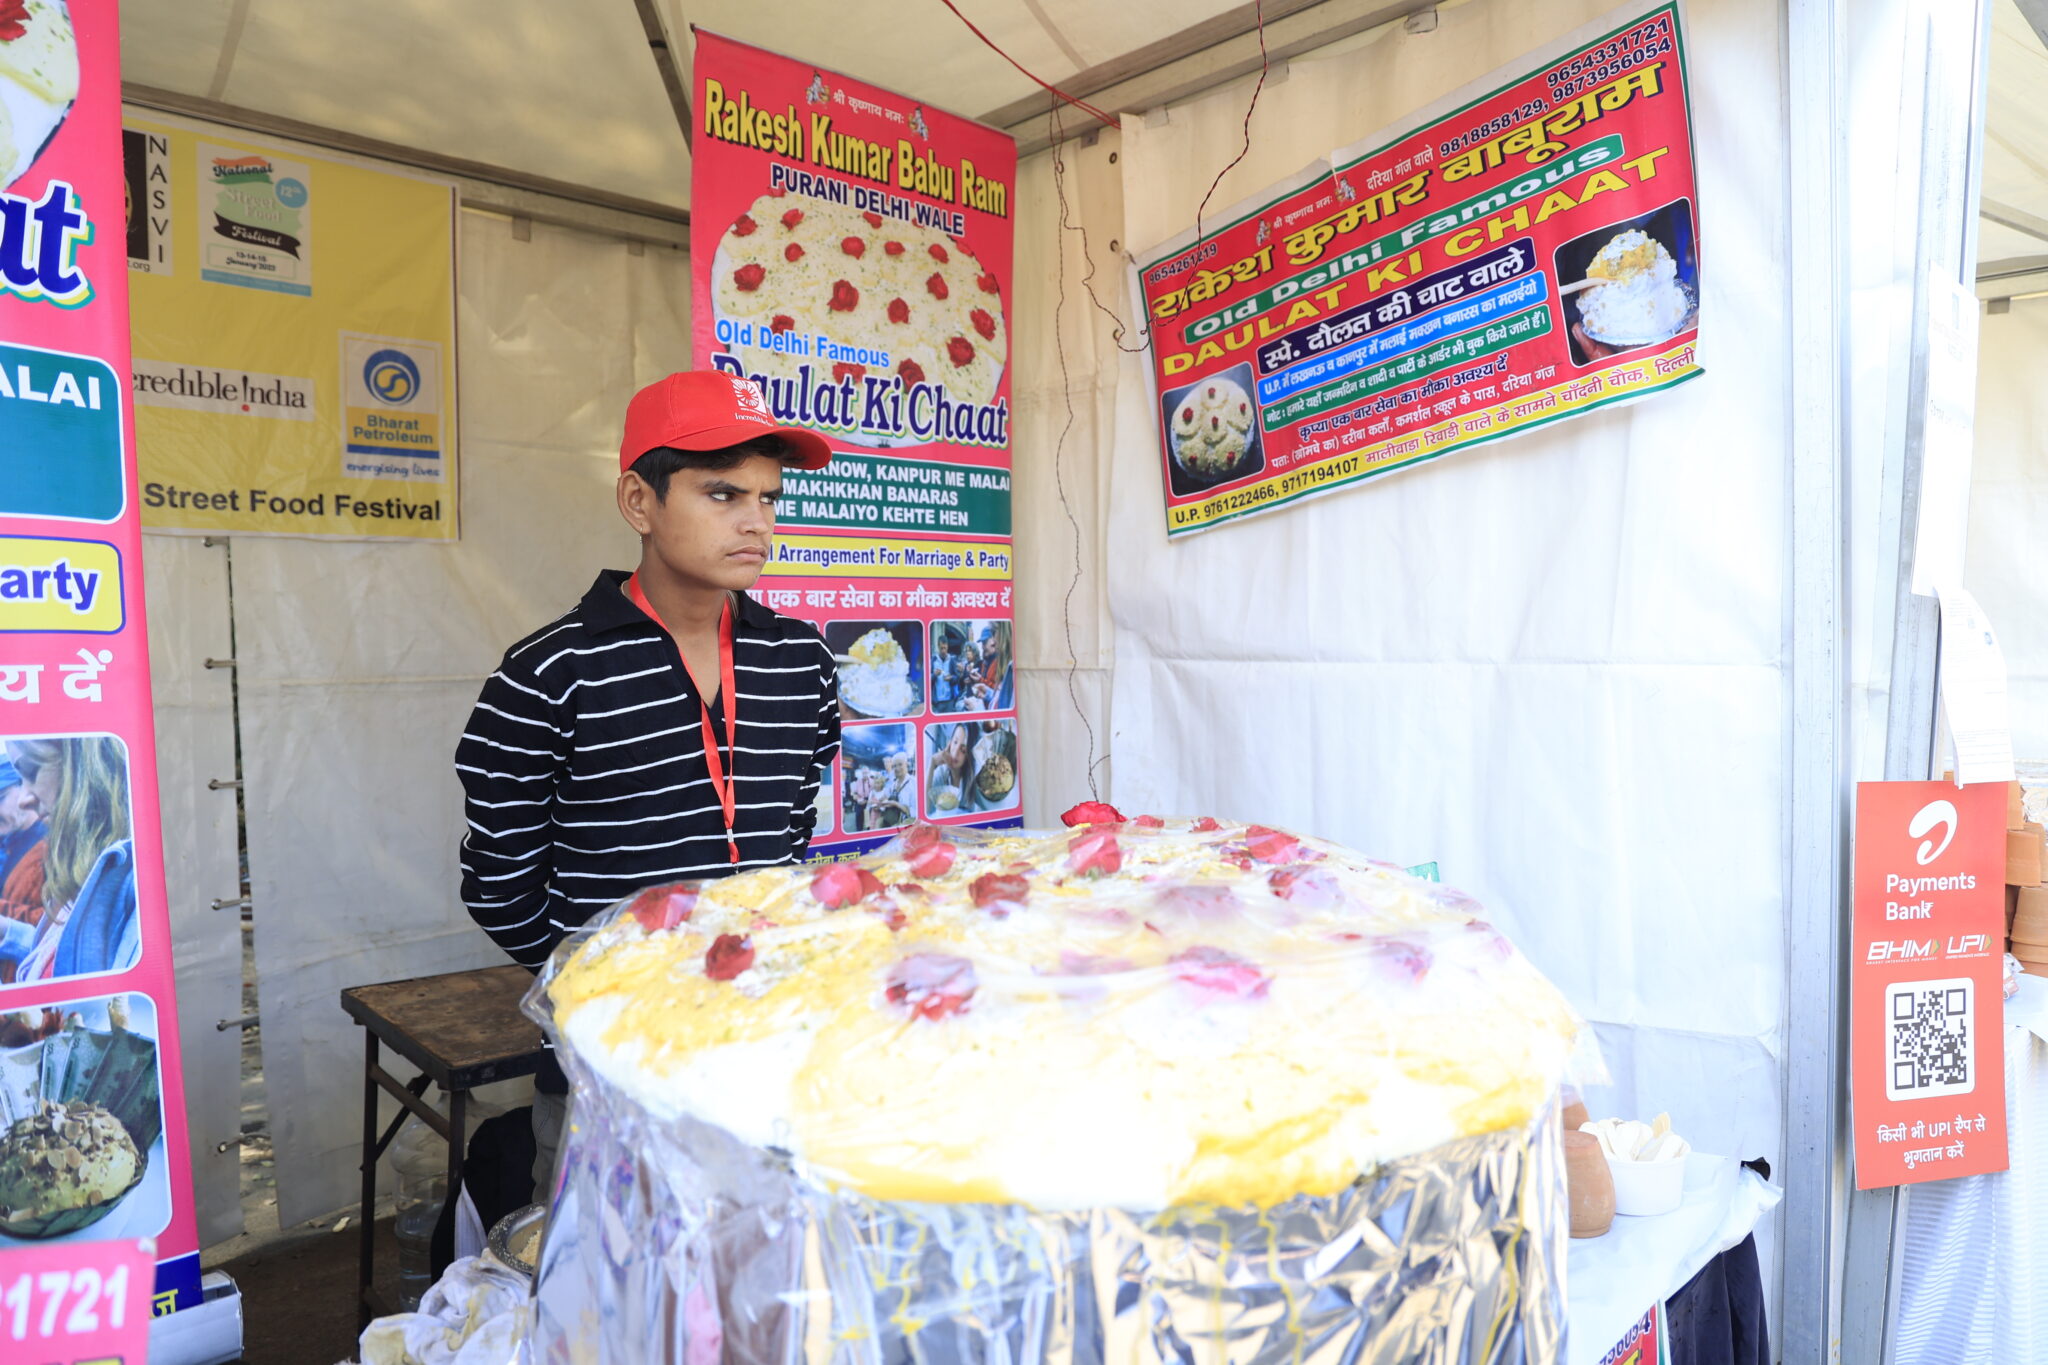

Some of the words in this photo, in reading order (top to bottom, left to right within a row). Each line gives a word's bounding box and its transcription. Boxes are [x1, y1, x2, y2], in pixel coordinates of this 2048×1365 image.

[1547, 17, 1670, 87] 9654331721
[833, 89, 845, 106] श्री
[1366, 168, 1394, 190] दरिया
[1395, 158, 1412, 176] गंज
[1413, 144, 1434, 168] वाले
[1440, 98, 1550, 158] 9818858129,
[1552, 37, 1672, 103] 9873956054
[704, 77, 804, 162] Rakesh
[810, 111, 893, 185] Kumar
[897, 139, 955, 204] Babu
[961, 158, 1007, 219] Ram
[1282, 170, 1433, 266] कुमार
[1439, 61, 1667, 182] बाबूराम
[213, 163, 273, 178] National
[149, 135, 168, 263] NASVI
[226, 187, 277, 210] Street
[245, 205, 282, 222] Food
[771, 163, 848, 206] PURANI
[854, 187, 910, 222] DELHI
[916, 203, 965, 236] WALE
[232, 225, 281, 246] Festival
[1193, 299, 1258, 335] Old
[1272, 242, 1383, 304] Delhi
[1401, 147, 1611, 248] Famous
[1162, 282, 1348, 377] DAULAT
[1366, 250, 1424, 293] KI
[1444, 146, 1670, 258] CHAAT
[1264, 340, 1301, 370] स्पे.
[1306, 322, 1372, 352] दौलत
[1376, 291, 1412, 323] की
[1416, 274, 1465, 306] चाट
[1467, 246, 1525, 286] वाले
[716, 319, 752, 346] Old
[759, 326, 810, 355] Delhi
[816, 336, 890, 367] Famous
[1264, 379, 1282, 395] U.P.
[1291, 364, 1326, 385] लखनऊ
[1336, 347, 1368, 366] कानपुर
[1380, 326, 1407, 351] मलाई
[1481, 298, 1497, 313] का
[1323, 381, 1358, 402] जन्मदिन
[1367, 370, 1388, 387] शादी
[1417, 354, 1427, 369] के
[1452, 338, 1465, 356] भी
[861, 376, 903, 433] Ki
[909, 383, 1007, 445] Chaat
[1331, 413, 1351, 429] एक
[1375, 396, 1398, 415] सेवा
[1400, 388, 1418, 404] का
[1420, 378, 1452, 399] मौका
[1453, 361, 1494, 387] अवश्य
[1433, 398, 1457, 418] स्कूल
[1459, 389, 1471, 405] के
[1501, 372, 1533, 393] दरिया
[1534, 363, 1556, 382] गंज
[353, 426, 434, 444] Petroleum
[367, 415, 420, 431] Bharat
[1174, 508, 1201, 524] U.P.
[1203, 484, 1279, 519] 9761222466,
[1281, 457, 1360, 494] 9717194107
[1424, 421, 1460, 448] रिवाड़ी
[1464, 411, 1492, 432] वाले
[1496, 406, 1511, 423] के
[1514, 390, 1557, 418] सामने
[1653, 347, 1697, 377] दिल्ली
[346, 461, 409, 477] energising
[412, 462, 440, 477] lives
[876, 465, 941, 485] KANPUR
[945, 471, 966, 487] ME
[969, 474, 1010, 491] MALAI
[143, 482, 240, 512] Street
[250, 490, 325, 517] Food
[334, 495, 442, 522] Festival
[782, 478, 882, 501] MAKHKHAN
[887, 488, 959, 506] BANARAS
[802, 502, 878, 521] MALAIYO
[883, 507, 935, 524] KEHTE
[940, 511, 969, 527] HEN
[779, 544, 875, 567] Arrangement
[880, 548, 900, 565] For
[905, 549, 961, 570] Marriage
[965, 552, 975, 567] &
[980, 553, 1009, 572] Party
[0, 562, 98, 611] arty
[767, 589, 801, 608] एक
[806, 589, 838, 608] बार
[840, 584, 874, 608] सेवा
[879, 589, 902, 608] का
[906, 584, 948, 608] मौका
[951, 589, 997, 608] अवश्य
[1886, 872, 1976, 897] Payments
[1886, 900, 1934, 921] Bank
[1867, 938, 1932, 961] BHIM
[1946, 934, 1986, 954] UPI
[1877, 1121, 1907, 1144] किसी
[1910, 1119, 1926, 1140] भी
[1928, 1122, 1951, 1138] UPI
[1974, 1113, 1987, 1132] से
[1903, 1147, 1943, 1169] भुगतान
[1945, 1140, 1966, 1159] करें
[0, 1264, 129, 1341] 1721
